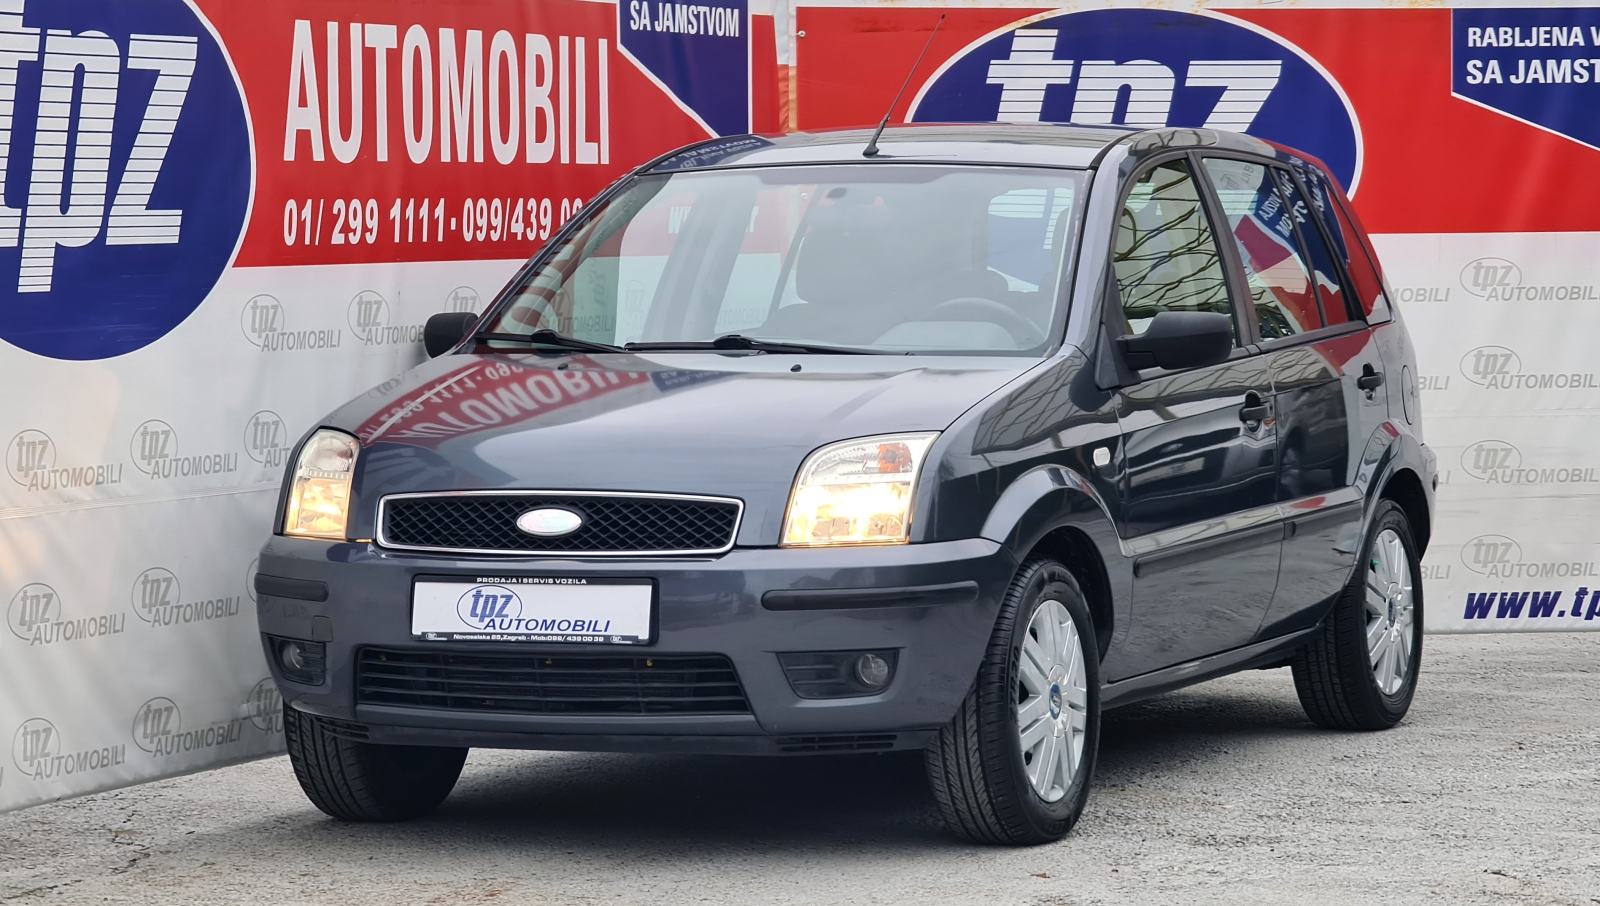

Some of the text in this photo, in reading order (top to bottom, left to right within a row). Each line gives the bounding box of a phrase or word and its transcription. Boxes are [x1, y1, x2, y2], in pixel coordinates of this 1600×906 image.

[630, 0, 740, 37] SA JAMSTVOM
[1467, 26, 1586, 48] RABLJENA
[1466, 58, 1600, 84] SA JAMST
[283, 19, 610, 165] AUTOMOBILI
[331, 198, 379, 245] 299
[1472, 262, 1513, 291] tpz
[1485, 286, 1600, 302] AUTOMOBIL
[250, 300, 280, 338] tpz
[357, 295, 383, 332] tpz
[261, 329, 342, 352] AUTOMOBILI
[1472, 350, 1513, 380] tpz
[1485, 374, 1600, 390] AUTOMOBIL
[140, 425, 171, 466] tpz
[252, 416, 280, 454] tpz
[16, 435, 49, 478] tpz
[150, 452, 238, 480] AUTOMOBILI
[1473, 445, 1513, 473] tpz
[28, 463, 123, 492] AUTOMOBILI
[1473, 540, 1513, 568] tpz
[19, 590, 54, 631] tpz
[142, 574, 174, 614] tpz
[469, 589, 514, 622] tpz
[30, 612, 125, 646] AUTOMOBILI
[152, 596, 240, 628] AUTOMOBILI
[483, 618, 611, 633] AUTOMOBILI
[142, 704, 174, 744] tpz
[153, 723, 242, 758] AUTOMOBILI
[22, 726, 52, 767] tpz
[32, 744, 126, 782] AUTOMOBILI
